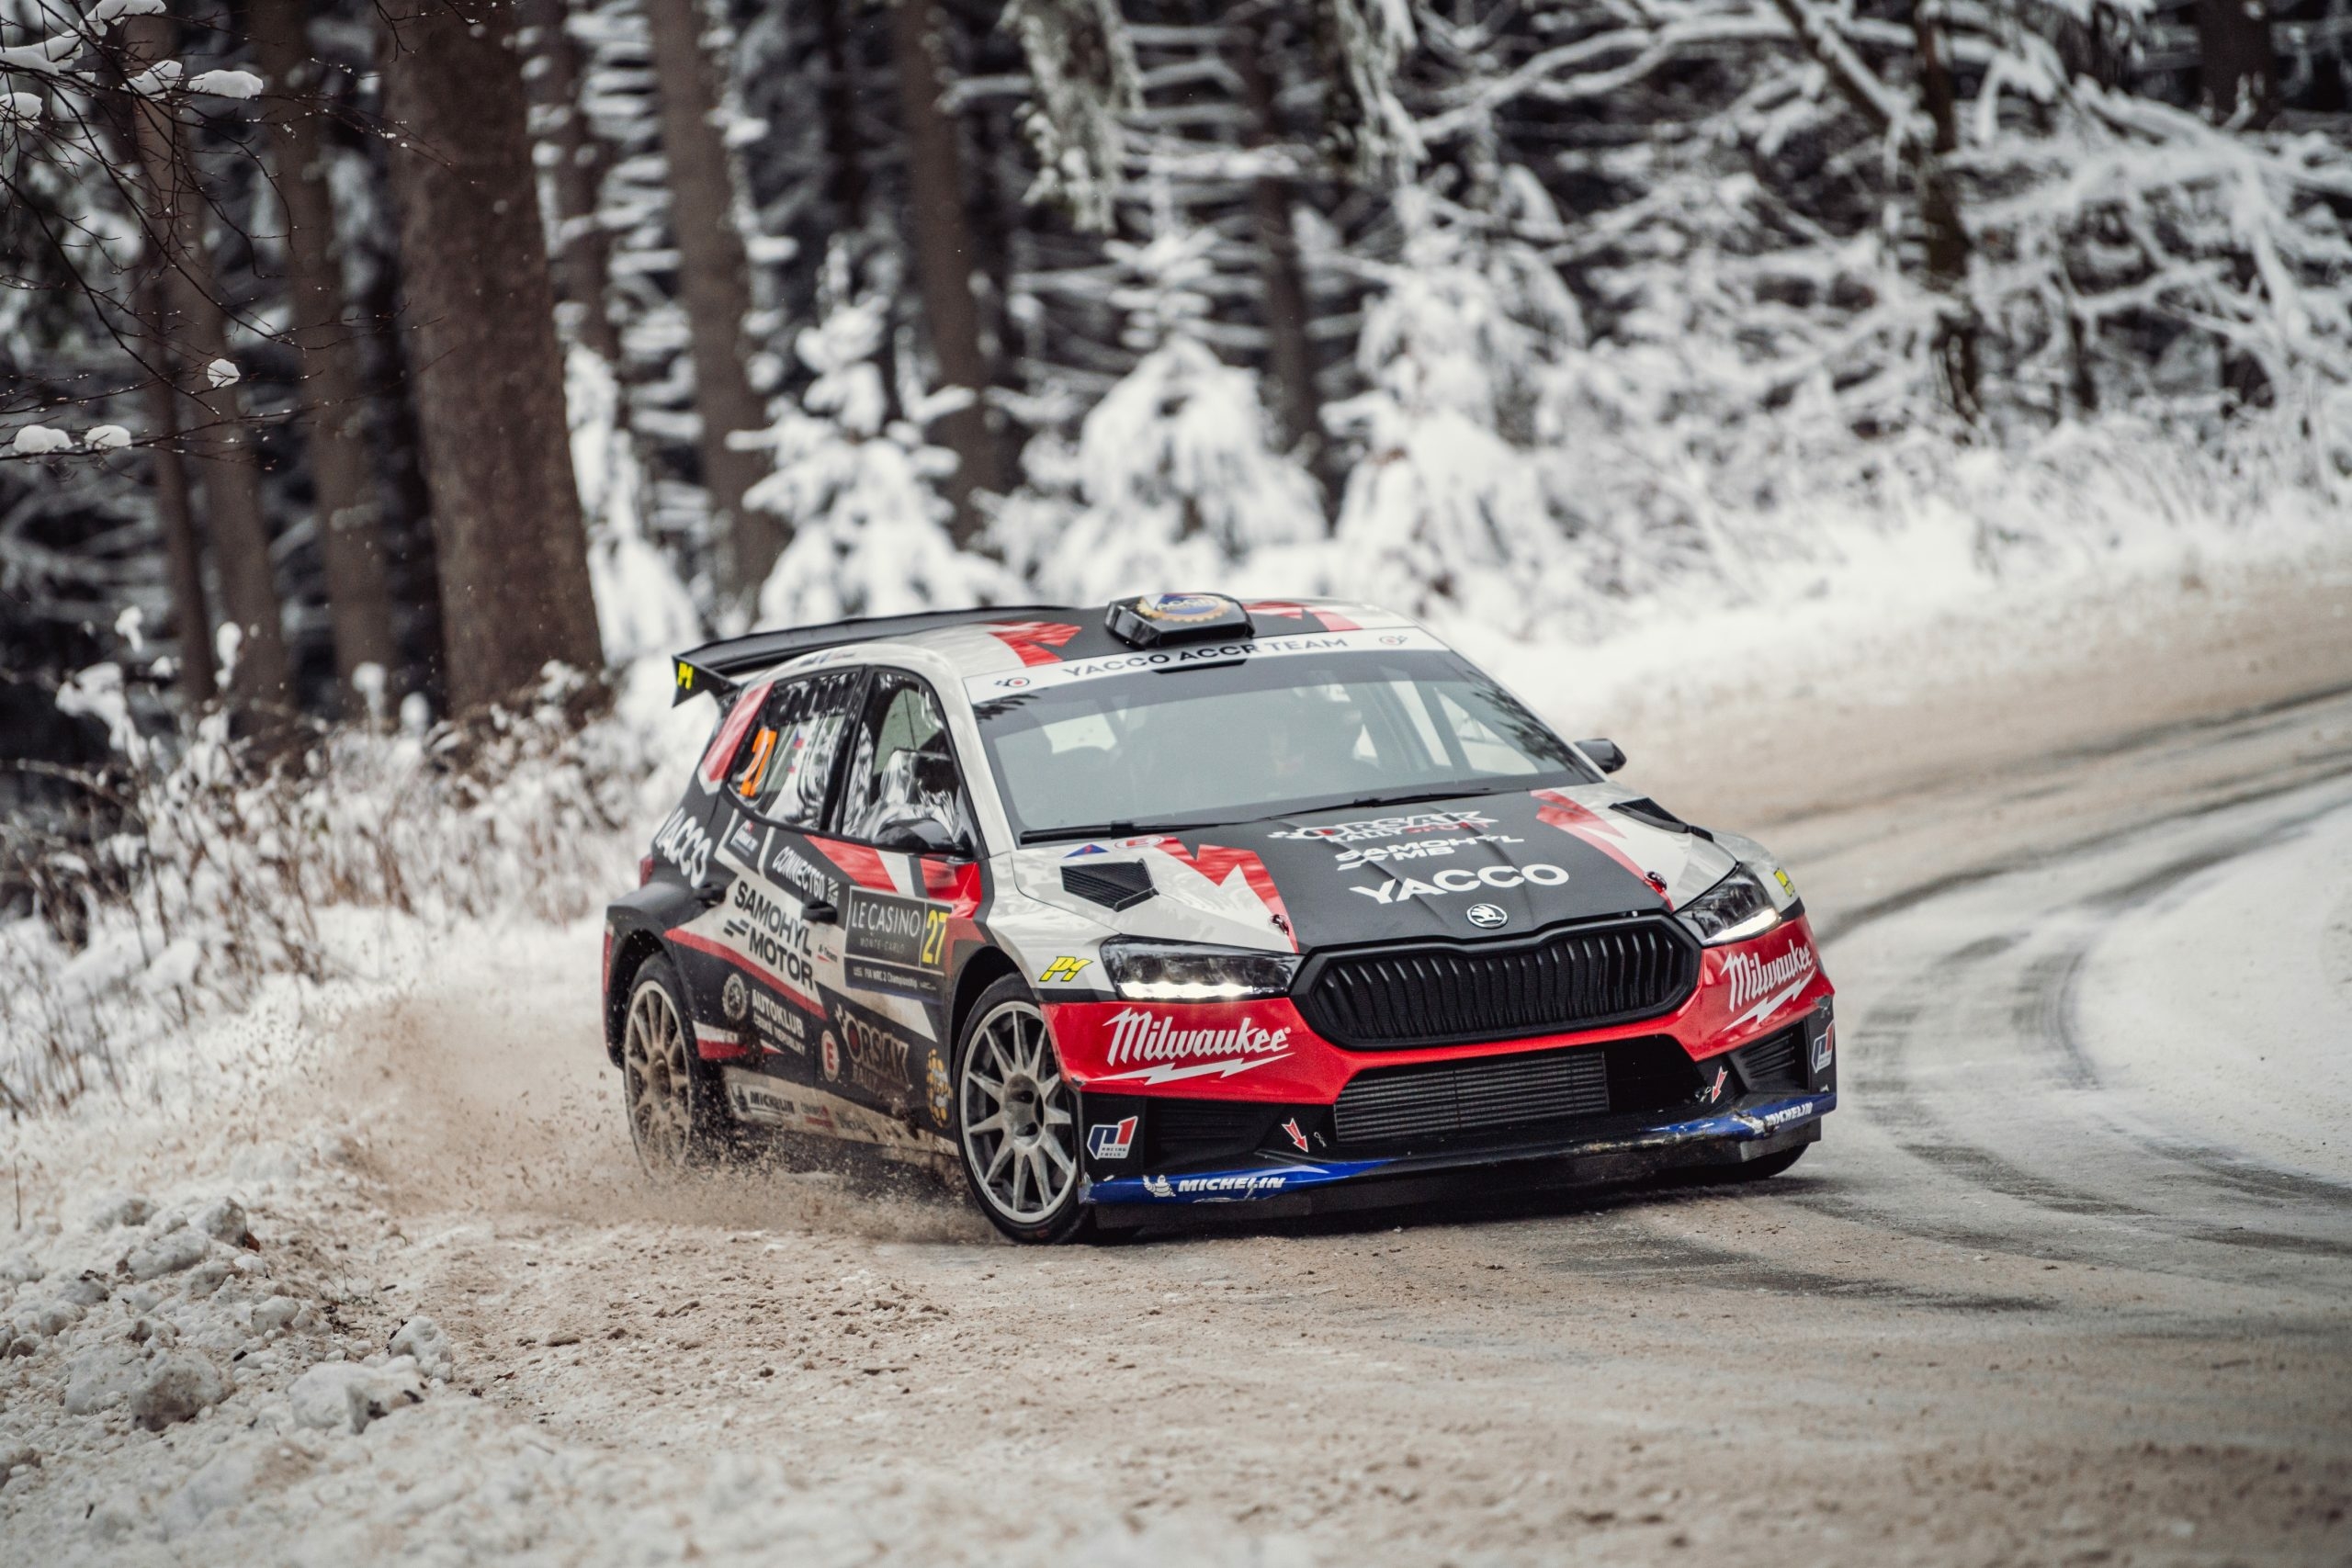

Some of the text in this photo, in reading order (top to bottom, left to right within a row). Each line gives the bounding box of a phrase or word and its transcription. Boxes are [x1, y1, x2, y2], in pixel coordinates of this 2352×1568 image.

[1062, 637, 1349, 677] YACCO ACCR TEAM
[1336, 834, 1524, 862] SAMOHYL
[1392, 846, 1455, 861] MB
[1349, 863, 1569, 905] YACCO
[735, 880, 812, 957] SAMOHYL
[852, 900, 866, 929] LE
[867, 903, 920, 938] CASINO
[922, 909, 950, 964] 27
[749, 926, 814, 991] MOTOR
[1720, 939, 1812, 1012] Milwaukee
[752, 988, 805, 1040] AUTOKLUB
[826, 1042, 834, 1070] E
[1102, 1007, 1289, 1066] Milwaukee
[1764, 1101, 1813, 1126] MICHELIN
[1178, 1177, 1287, 1192] MICHELIN
